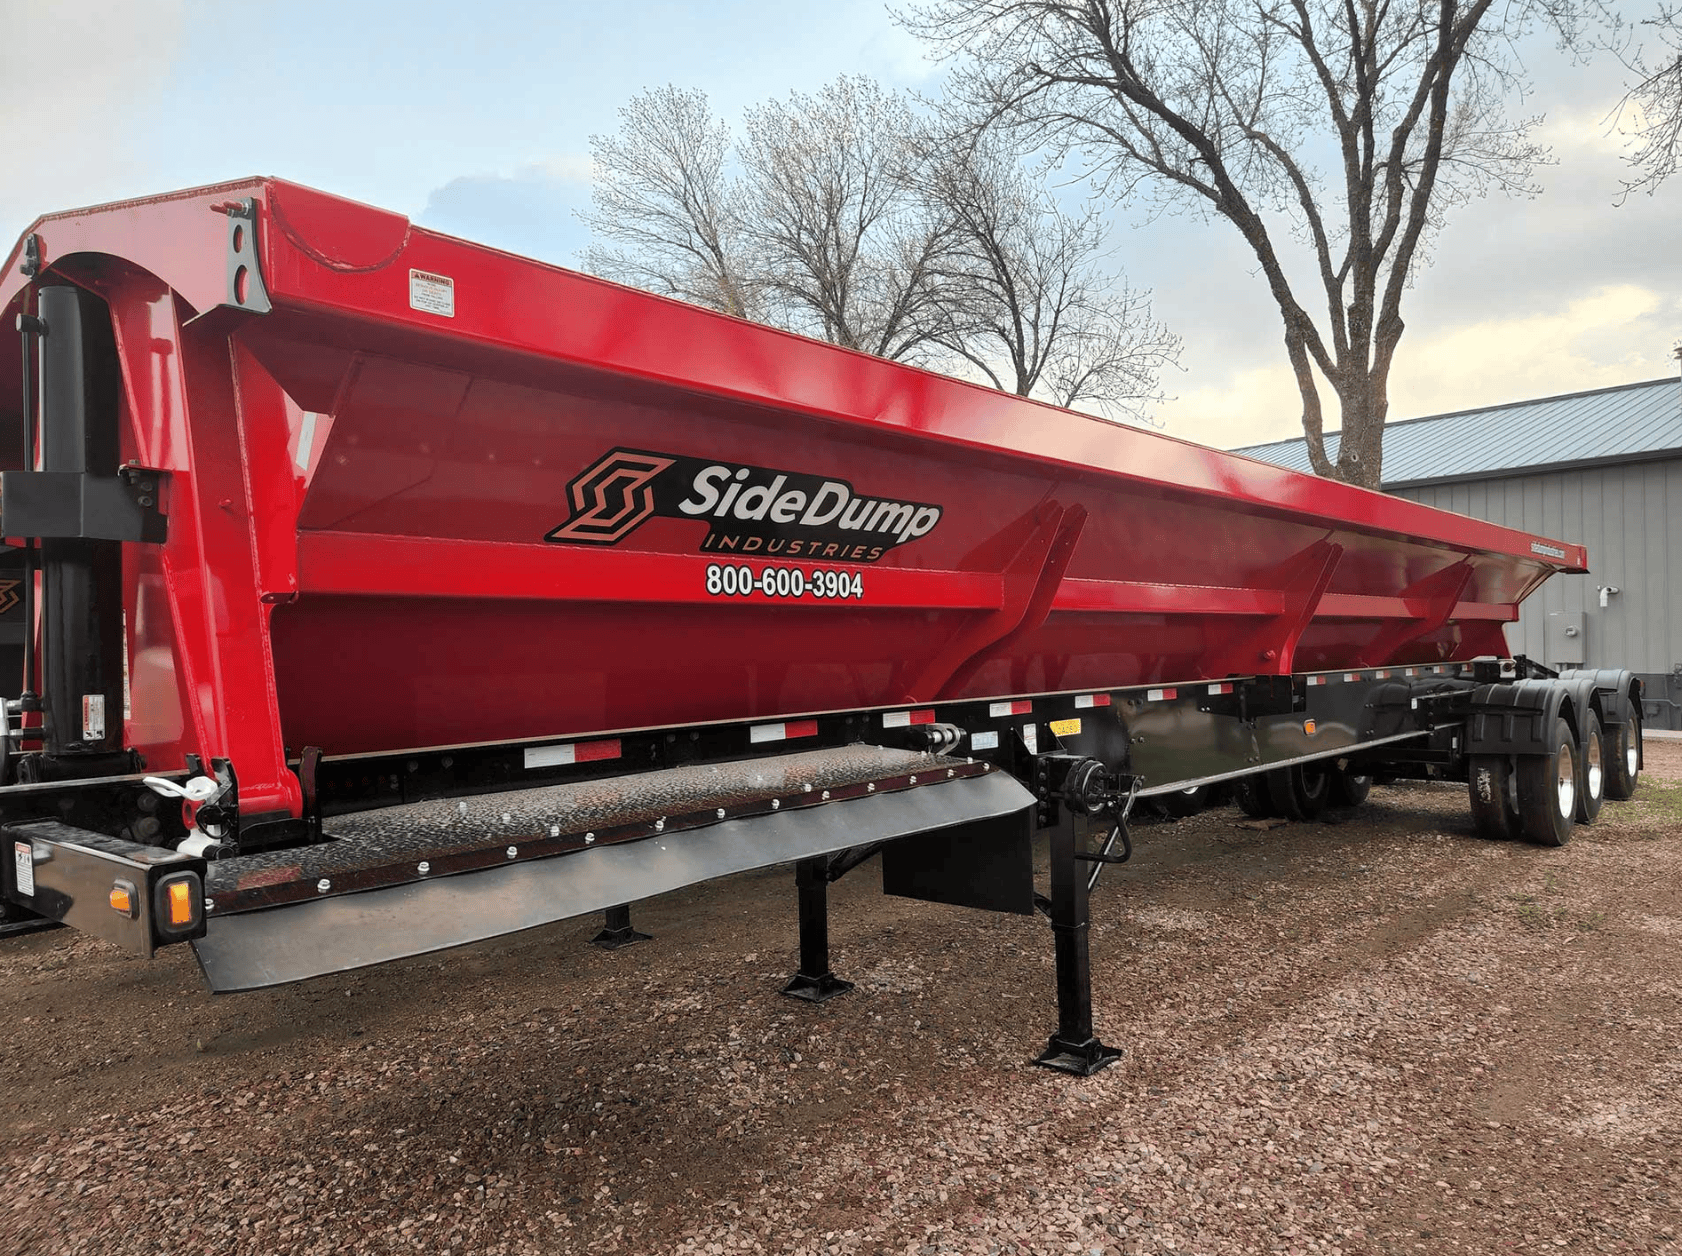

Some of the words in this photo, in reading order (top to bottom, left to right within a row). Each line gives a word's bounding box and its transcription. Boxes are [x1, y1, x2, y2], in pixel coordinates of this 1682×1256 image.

[420, 273, 450, 286] WARNING
[704, 534, 884, 560] INDUSTRIES
[706, 565, 863, 598] 800-600-3904
